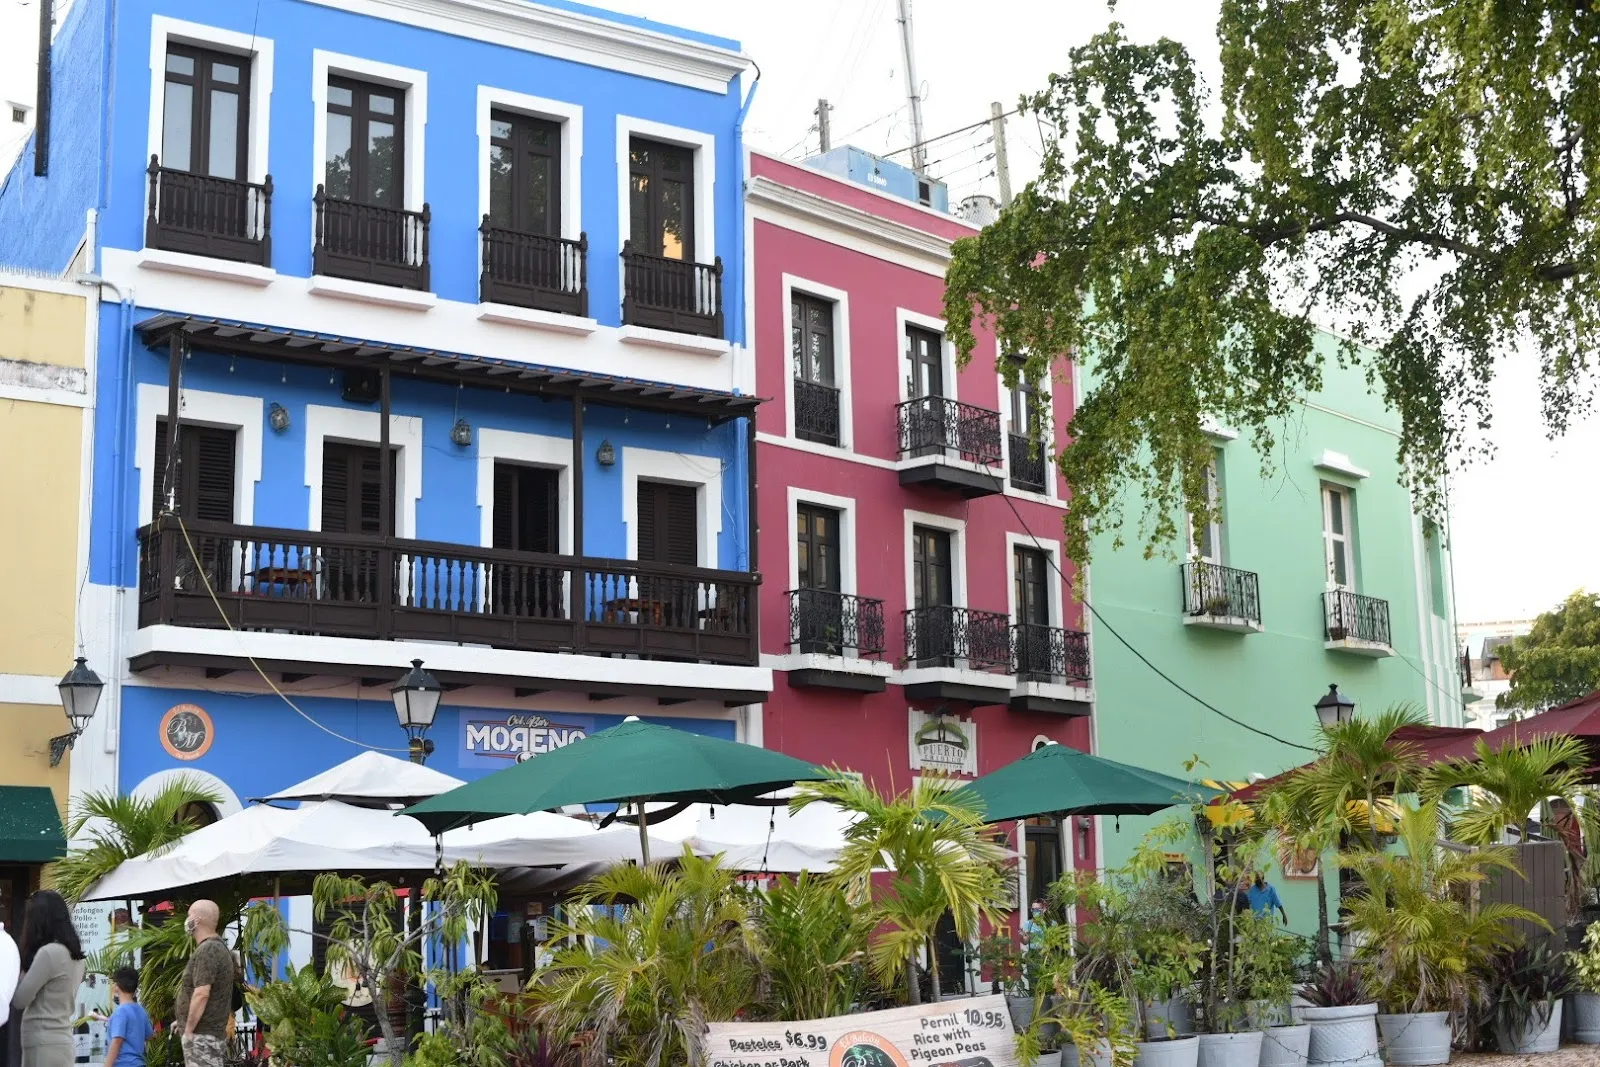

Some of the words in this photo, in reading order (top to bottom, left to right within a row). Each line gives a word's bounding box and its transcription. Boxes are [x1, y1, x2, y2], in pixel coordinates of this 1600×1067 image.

[526, 715, 549, 728] Bar
[923, 744, 963, 758] PUERTO
[73, 907, 104, 916] onfongos
[920, 1013, 960, 1029] Pernil
[729, 1037, 783, 1052] Pasteles
[785, 1029, 828, 1050] $6.99
[913, 1032, 940, 1045] Rice
[942, 1027, 971, 1041] with
[910, 1046, 954, 1061] Pigeon
[955, 1041, 986, 1054] Peas
